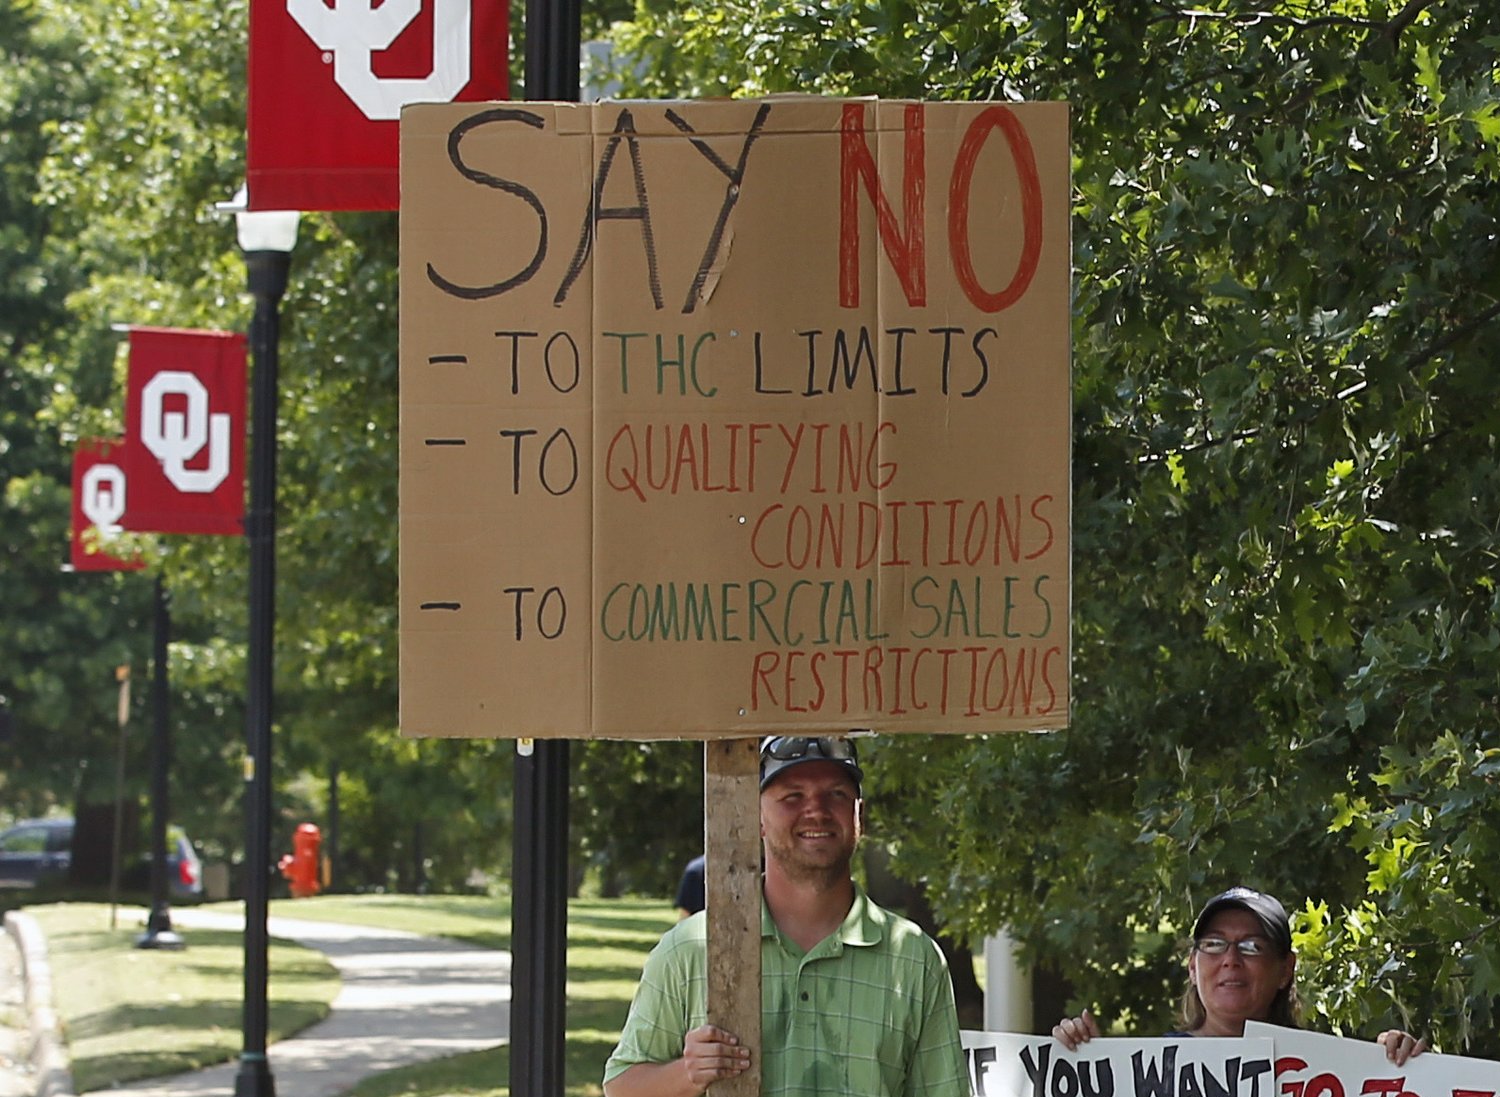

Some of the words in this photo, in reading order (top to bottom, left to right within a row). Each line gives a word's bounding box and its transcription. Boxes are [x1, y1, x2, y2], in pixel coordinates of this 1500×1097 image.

[426, 103, 771, 313] SAY
[838, 103, 1043, 313] NO
[495, 331, 580, 395] TO
[602, 331, 719, 397] THC
[754, 325, 999, 397] LIMITS
[500, 428, 579, 495] TO
[604, 421, 897, 502] QUALIFYING
[751, 494, 1054, 570] CONDITIONS
[503, 586, 567, 641] TO
[600, 577, 890, 646] COMMERCIAL
[909, 574, 1053, 640] SALES
[750, 645, 1062, 718] RESTRICTIONS
